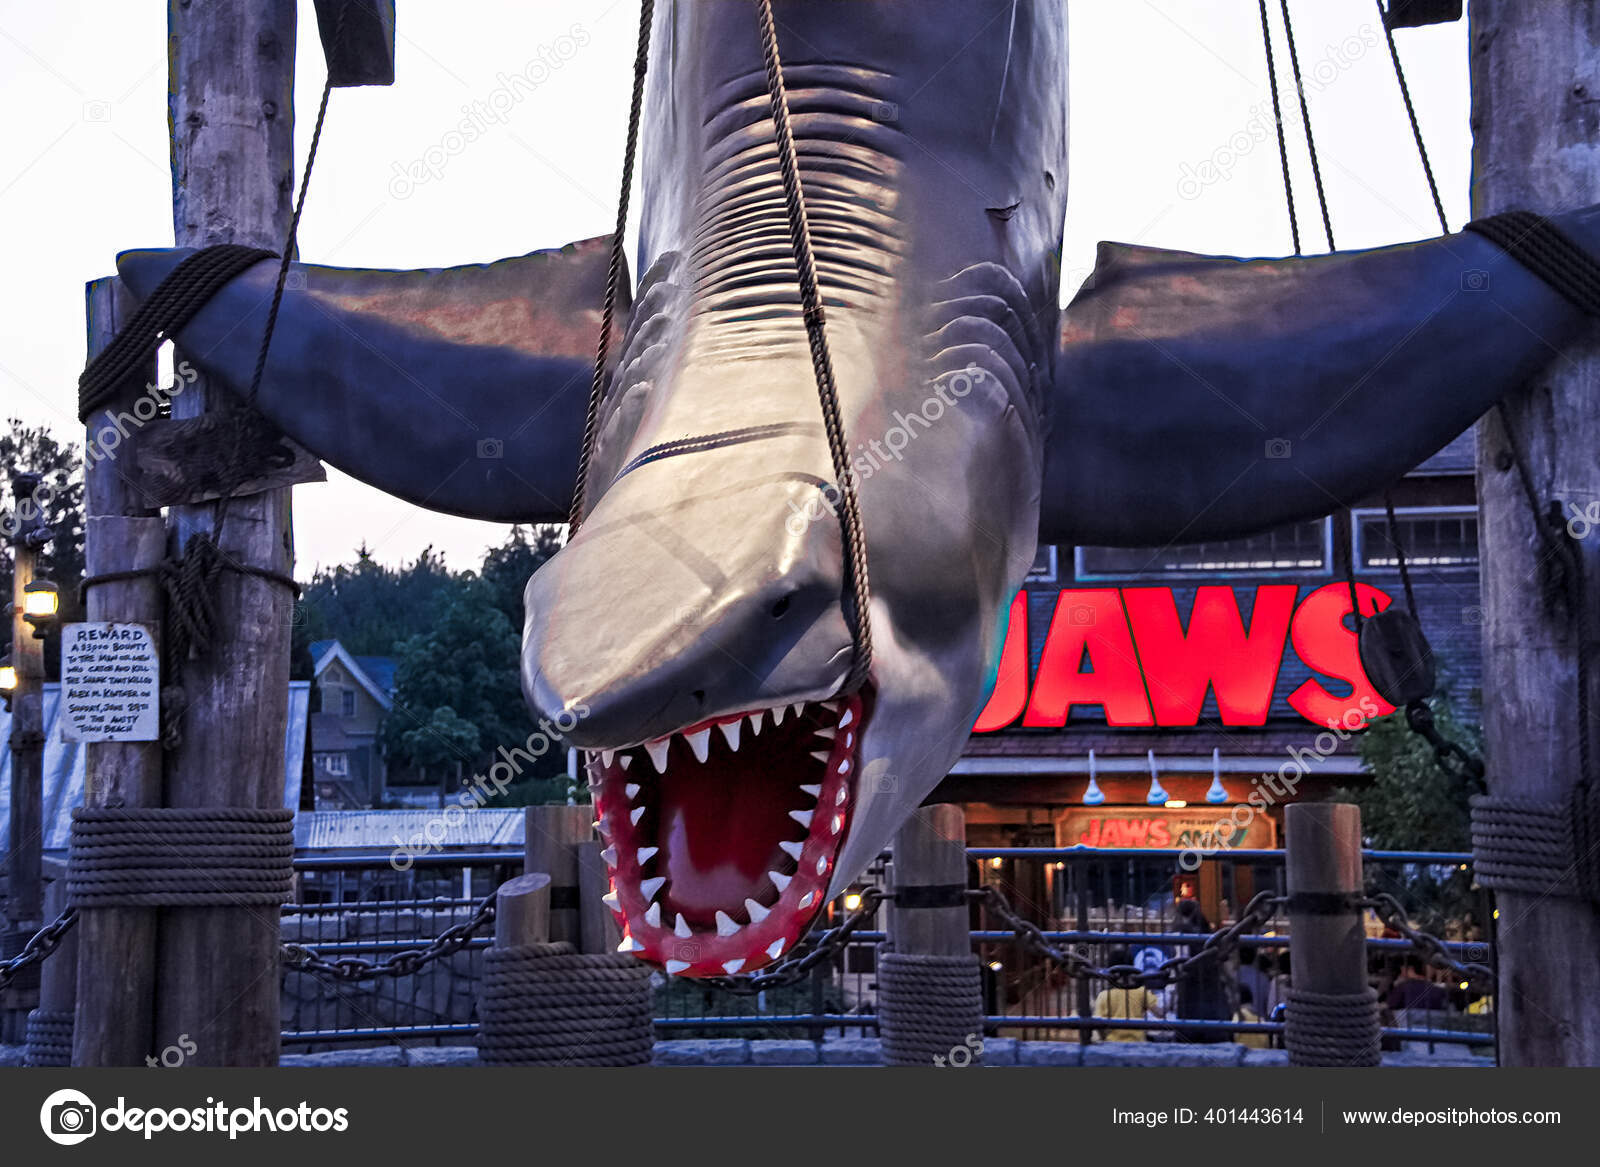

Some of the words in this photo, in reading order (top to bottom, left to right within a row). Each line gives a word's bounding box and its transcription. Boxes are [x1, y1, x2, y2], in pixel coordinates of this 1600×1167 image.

[77, 629, 143, 641] REWARD
[71, 644, 79, 652] A
[113, 642, 148, 652] BOUNTY
[67, 655, 77, 663] TO
[77, 654, 95, 663] THE
[98, 653, 118, 662] MAN
[971, 581, 1397, 733] JAWS
[66, 666, 83, 674] WHO
[88, 665, 113, 673] CATCH
[114, 665, 130, 673] AND
[131, 665, 149, 673] KILL
[65, 676, 80, 685] THE
[82, 675, 107, 684] SHARK
[108, 676, 127, 684] THAT
[127, 676, 153, 684] KILLED
[67, 689, 90, 699] ALEX
[103, 688, 138, 698] KINTNER
[140, 690, 151, 698] ON
[103, 703, 123, 711] JUNE
[90, 715, 105, 723] THE
[110, 715, 139, 724] AMITY
[76, 724, 102, 733] TOWN
[103, 724, 133, 733] BEACH
[1080, 818, 1170, 848] JAWS
